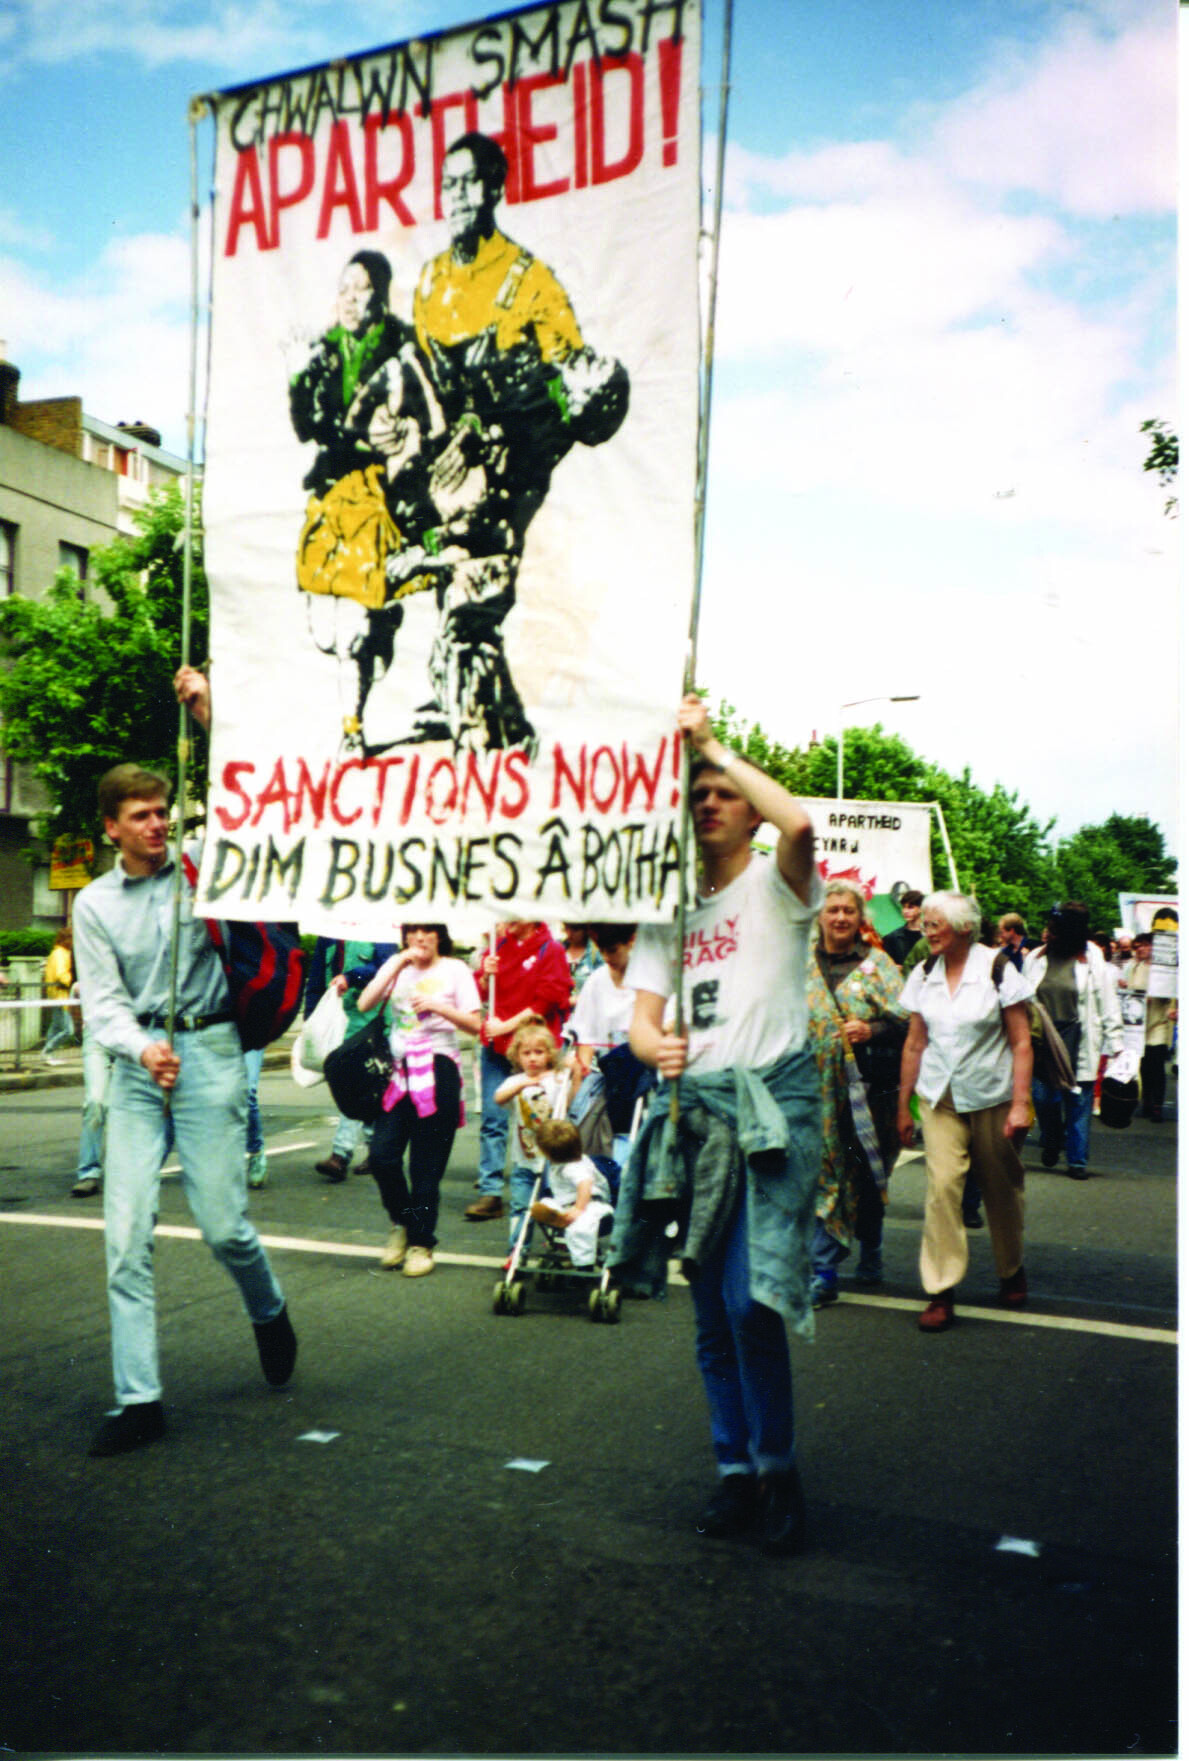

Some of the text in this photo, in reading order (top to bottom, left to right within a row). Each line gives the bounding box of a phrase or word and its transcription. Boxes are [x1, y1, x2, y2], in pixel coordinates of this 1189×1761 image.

[469, 0, 685, 100] SMASH
[214, 729, 682, 835] SANCTIONS NOW!
[828, 812, 902, 831] APARTHEID
[206, 833, 306, 907] DIM
[317, 832, 523, 909] BUSNES
